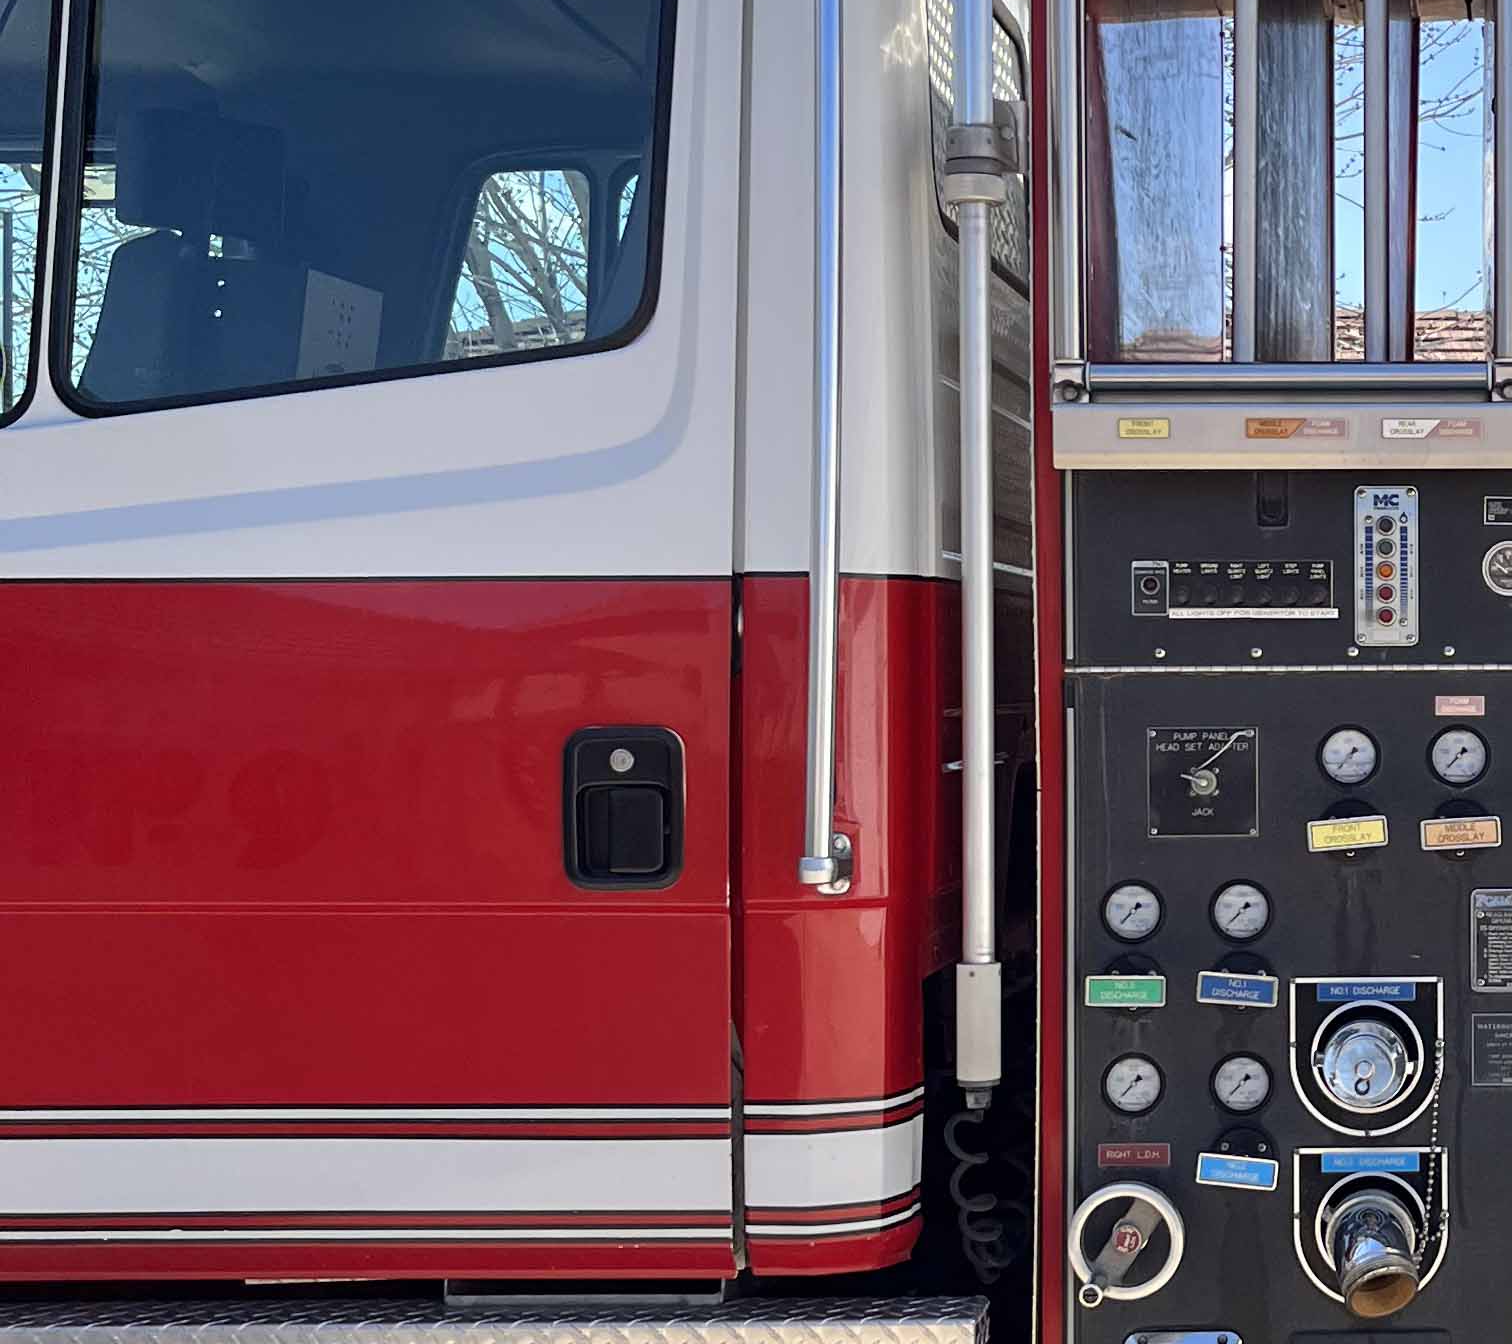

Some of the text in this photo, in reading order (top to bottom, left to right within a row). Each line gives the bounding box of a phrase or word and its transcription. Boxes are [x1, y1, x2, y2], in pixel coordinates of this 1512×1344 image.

[1374, 494, 1400, 506] MC
[1173, 732, 1231, 740] PUMP PANEL
[1156, 743, 1180, 752] HEAD
[1184, 743, 1202, 752] SET
[1192, 808, 1216, 816] JACK
[1332, 822, 1362, 833] FRONT
[1444, 822, 1477, 832] MIDDLE
[1324, 832, 1373, 844] CROSSLAY
[1438, 832, 1485, 843] CROSSLAY
[1211, 988, 1260, 1000] DISCHARGE
[1352, 986, 1401, 995] DISCHARGE
[1106, 1150, 1131, 1160] RIGHT
